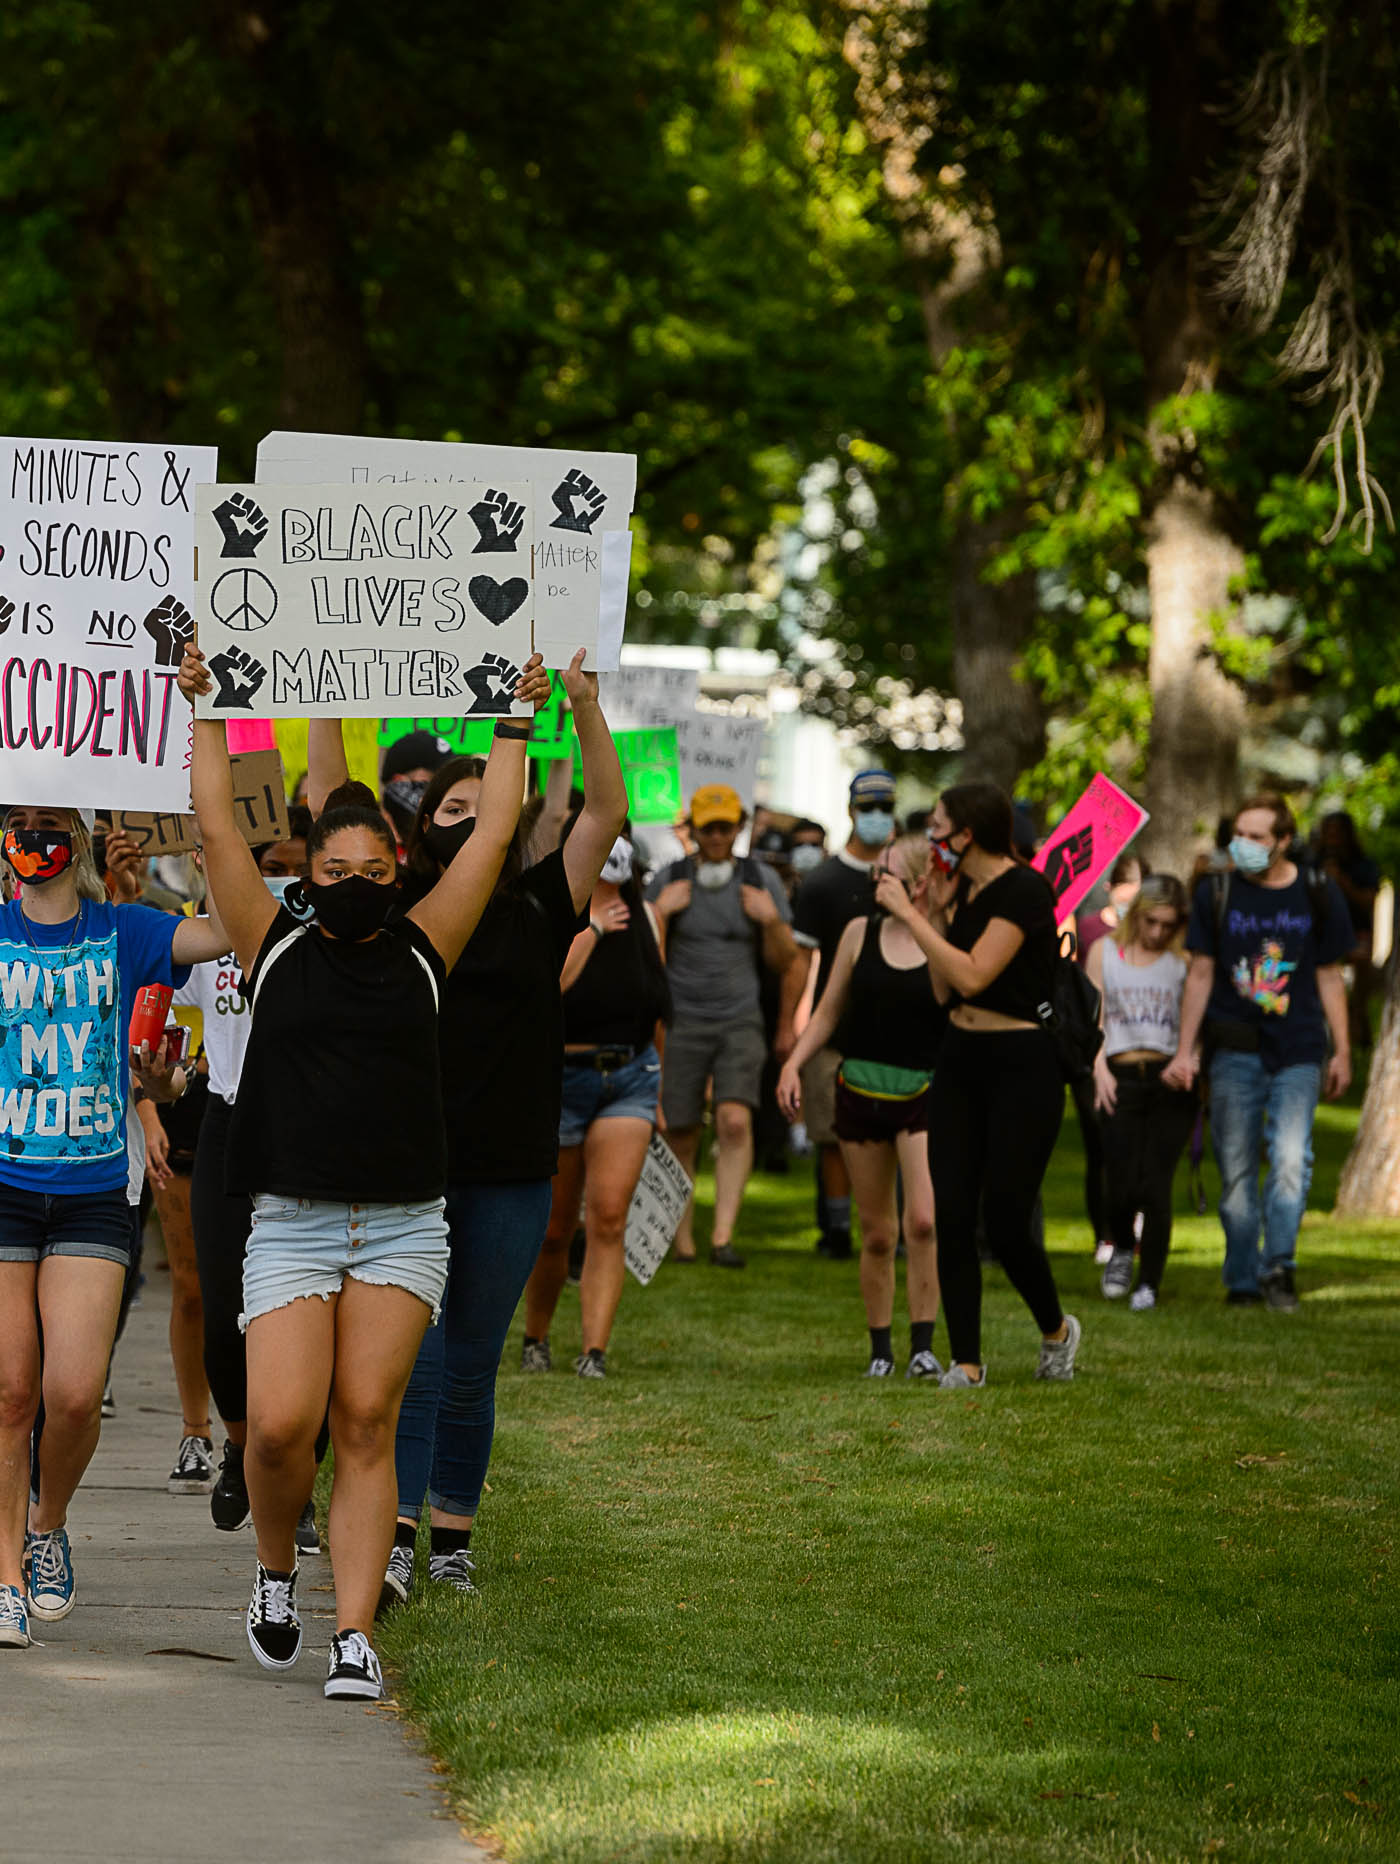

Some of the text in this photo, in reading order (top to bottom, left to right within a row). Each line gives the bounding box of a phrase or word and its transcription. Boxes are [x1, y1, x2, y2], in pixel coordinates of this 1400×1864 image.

[12, 446, 141, 506] MINUTES
[160, 450, 191, 513] &
[20, 519, 171, 587] SECONDS
[282, 503, 458, 564] BLACK
[311, 575, 466, 633] LIVES
[547, 584, 570, 597] be
[21, 602, 136, 641] IS NO
[272, 646, 464, 704] MATTER
[21, 1021, 94, 1075] MY
